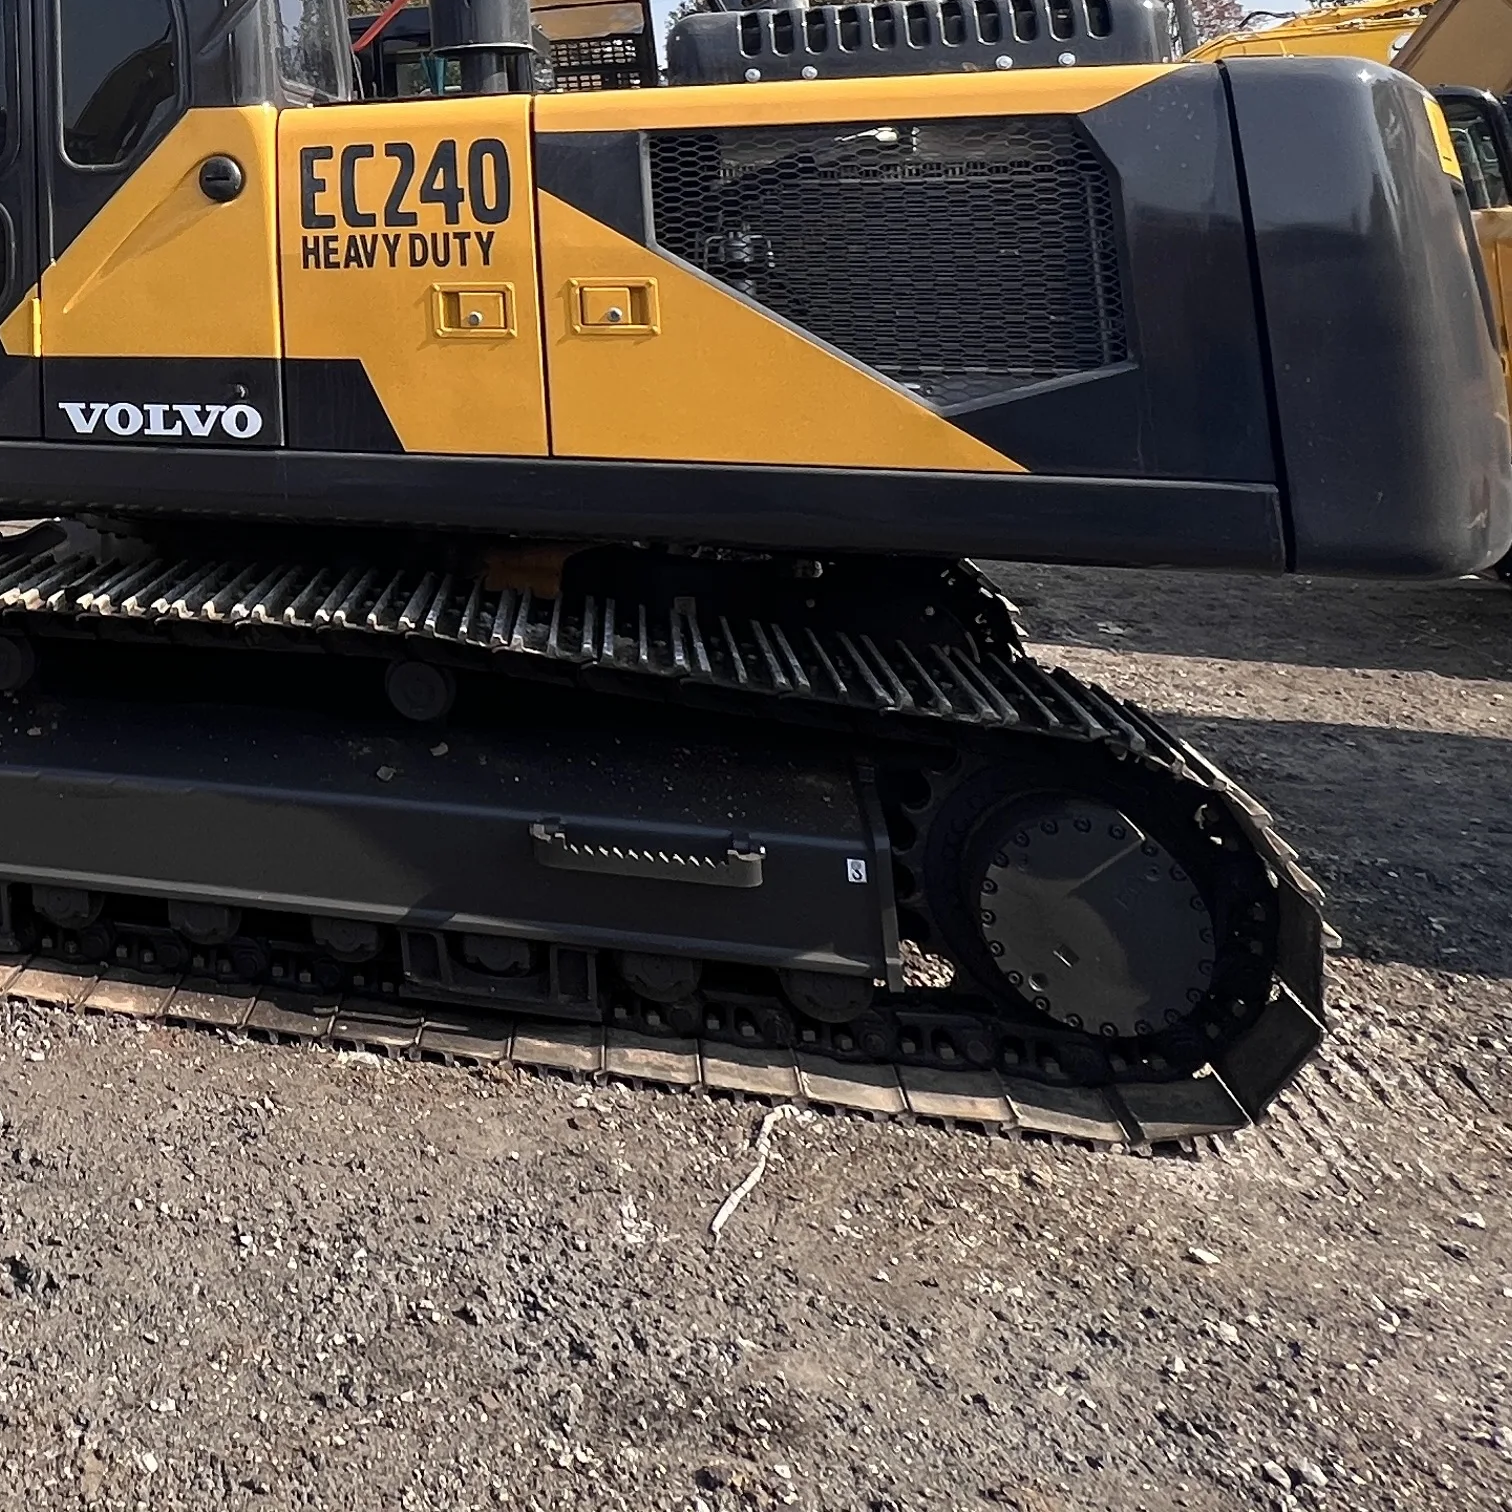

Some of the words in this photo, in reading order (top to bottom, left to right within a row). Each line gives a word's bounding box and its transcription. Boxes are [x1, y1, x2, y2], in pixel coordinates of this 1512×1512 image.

[300, 138, 511, 228] EC240
[302, 233, 401, 269] HEAVY
[409, 231, 495, 267] DUTY
[58, 402, 263, 438] VOLVO
